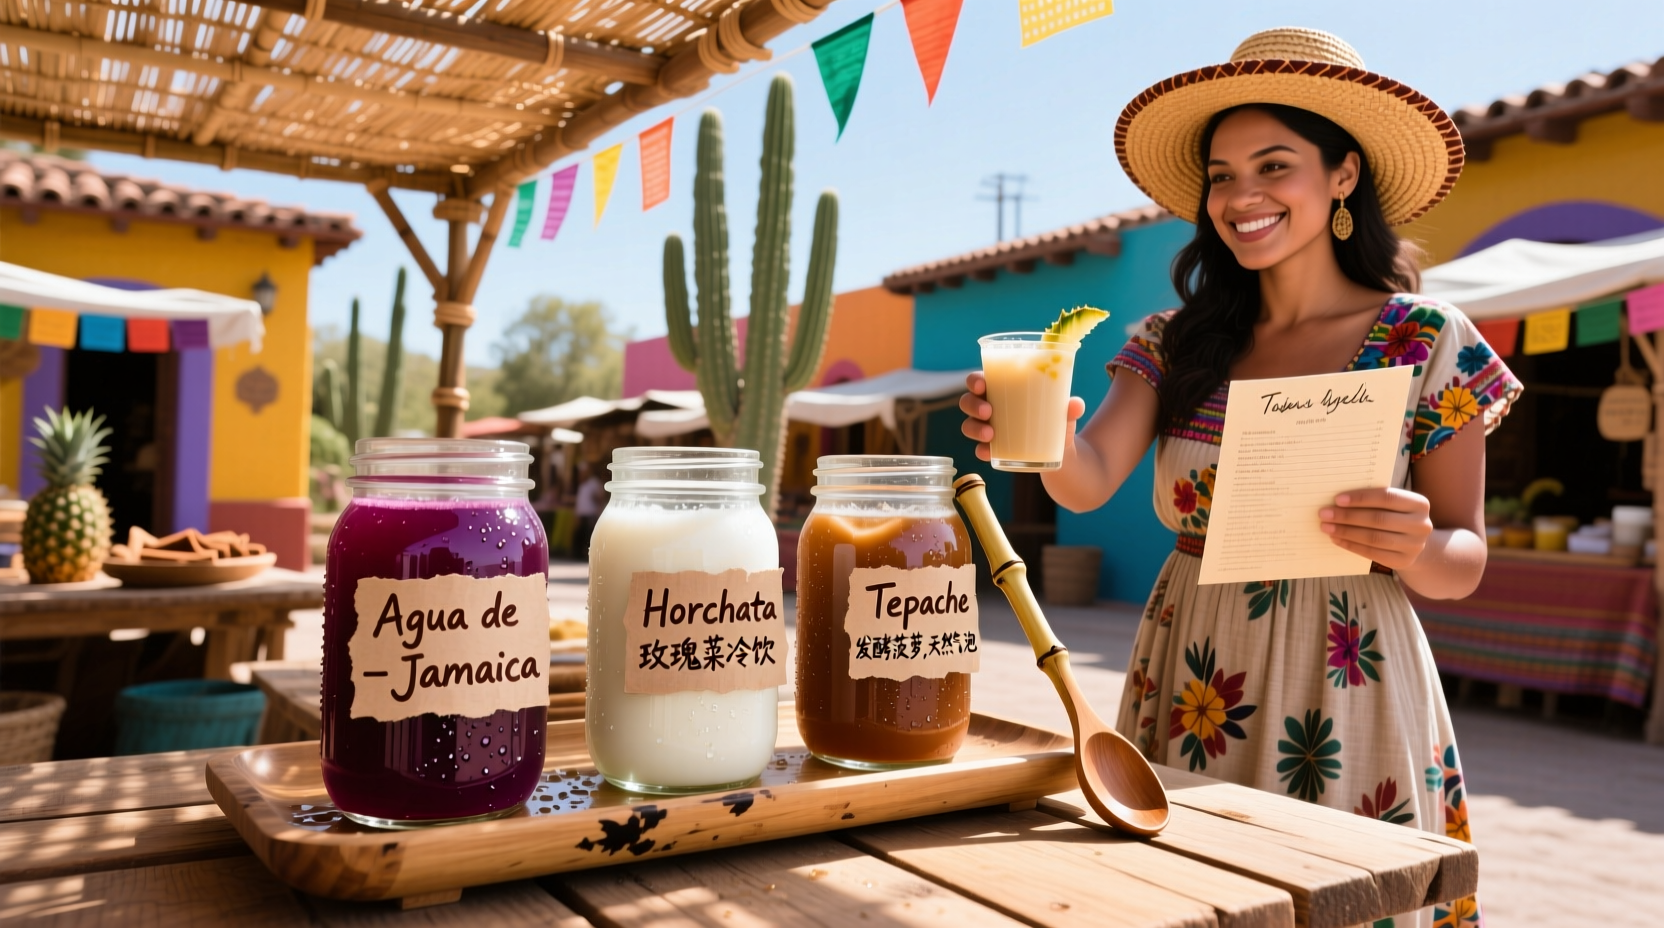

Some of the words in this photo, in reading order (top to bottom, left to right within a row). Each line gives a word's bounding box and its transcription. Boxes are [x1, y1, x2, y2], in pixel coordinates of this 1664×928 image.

[372, 592, 469, 650] Agua
[481, 590, 519, 629] de
[642, 587, 778, 629] Horchata
[865, 580, 970, 631] Tepache
